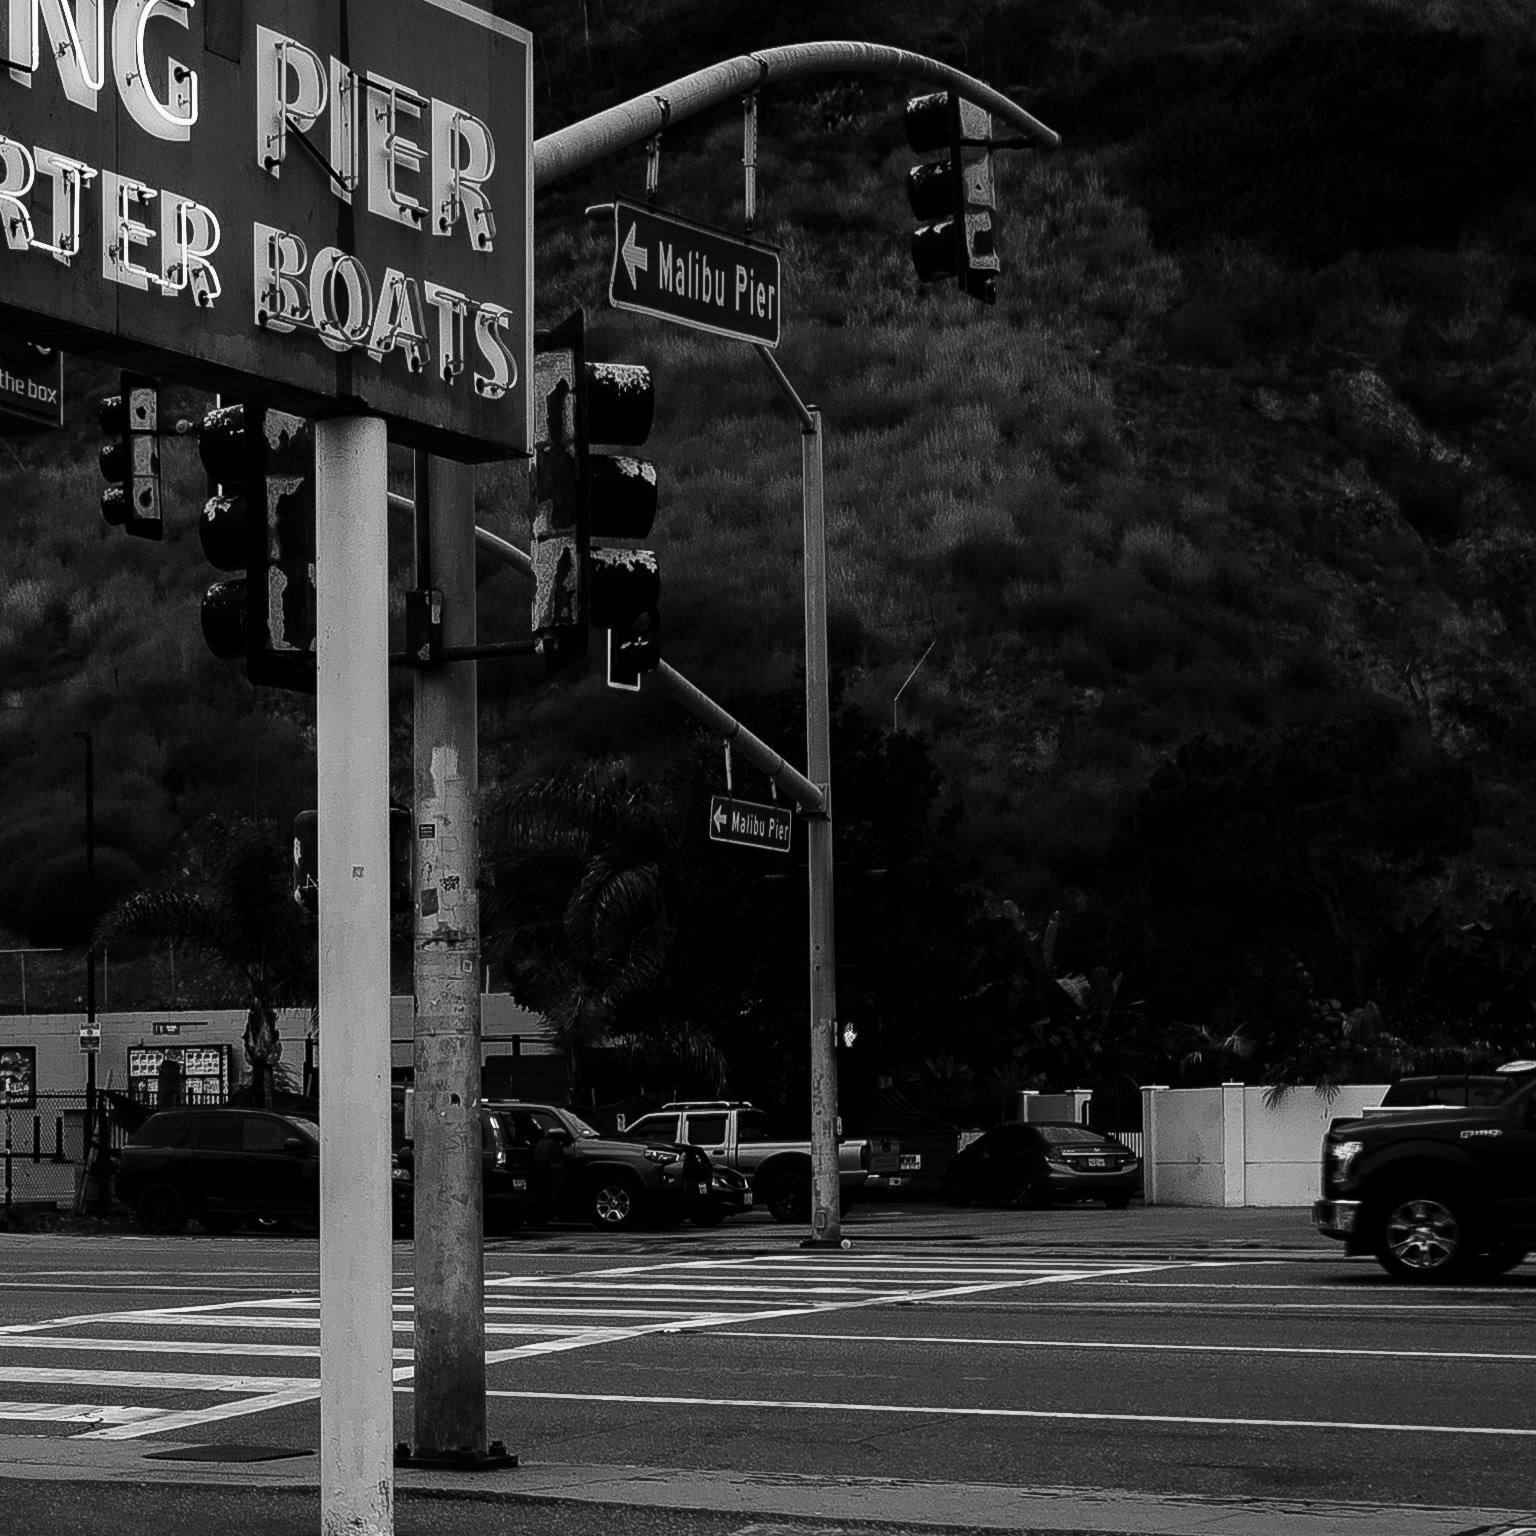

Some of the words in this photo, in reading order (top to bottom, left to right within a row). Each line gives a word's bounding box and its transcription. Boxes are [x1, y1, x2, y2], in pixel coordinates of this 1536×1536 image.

[256, 24, 496, 252] PIER
[254, 222, 518, 400] BOATS
[658, 240, 726, 307] Malibu
[735, 263, 776, 320] Pier
[27, 377, 57, 405] box
[731, 810, 765, 836] Malibu
[768, 817, 789, 841] Pier
